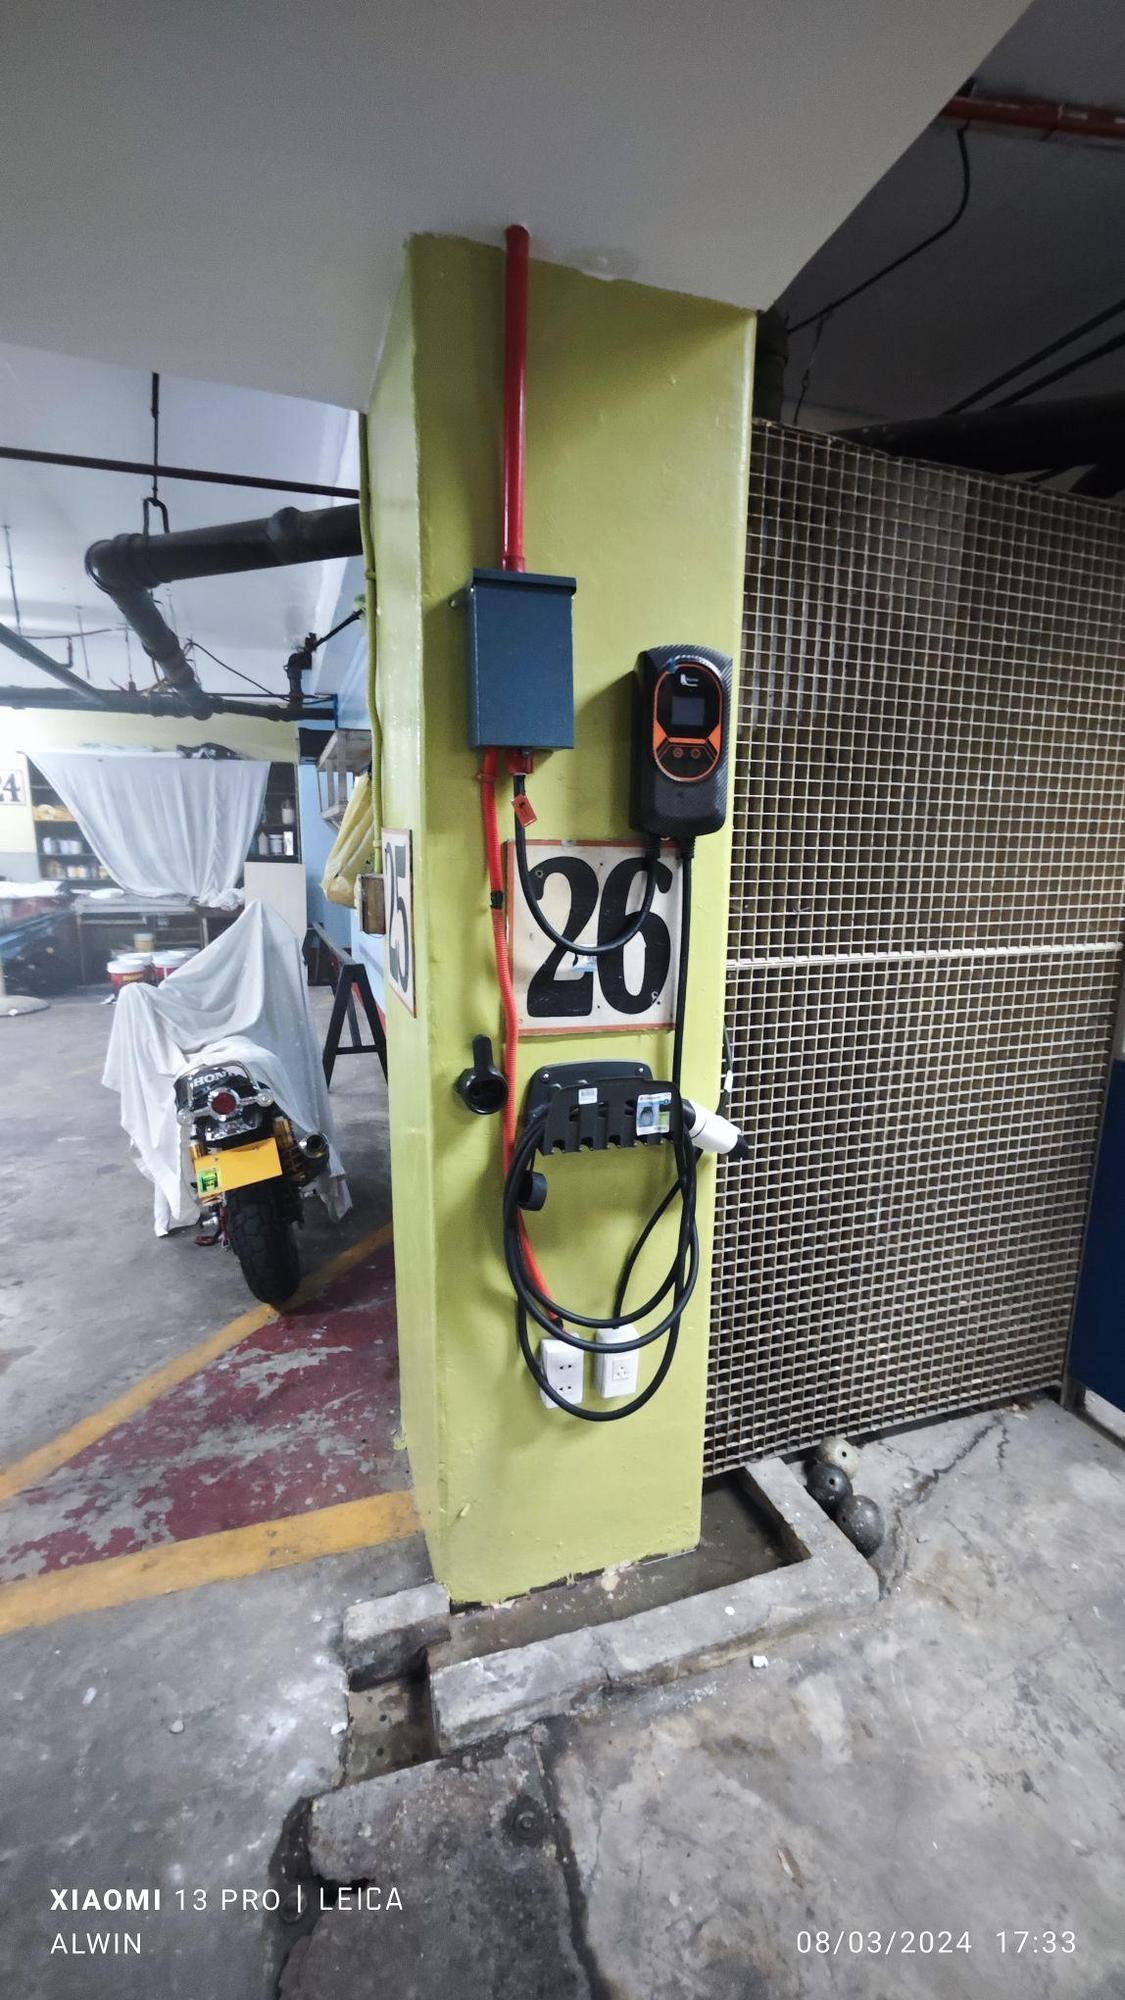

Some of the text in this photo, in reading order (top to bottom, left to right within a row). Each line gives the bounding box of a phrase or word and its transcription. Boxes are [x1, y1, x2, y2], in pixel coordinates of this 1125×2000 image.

[0, 772, 21, 802] 4
[384, 841, 410, 993] 25
[526, 855, 672, 1018] 26
[192, 1069, 232, 1087] HON
